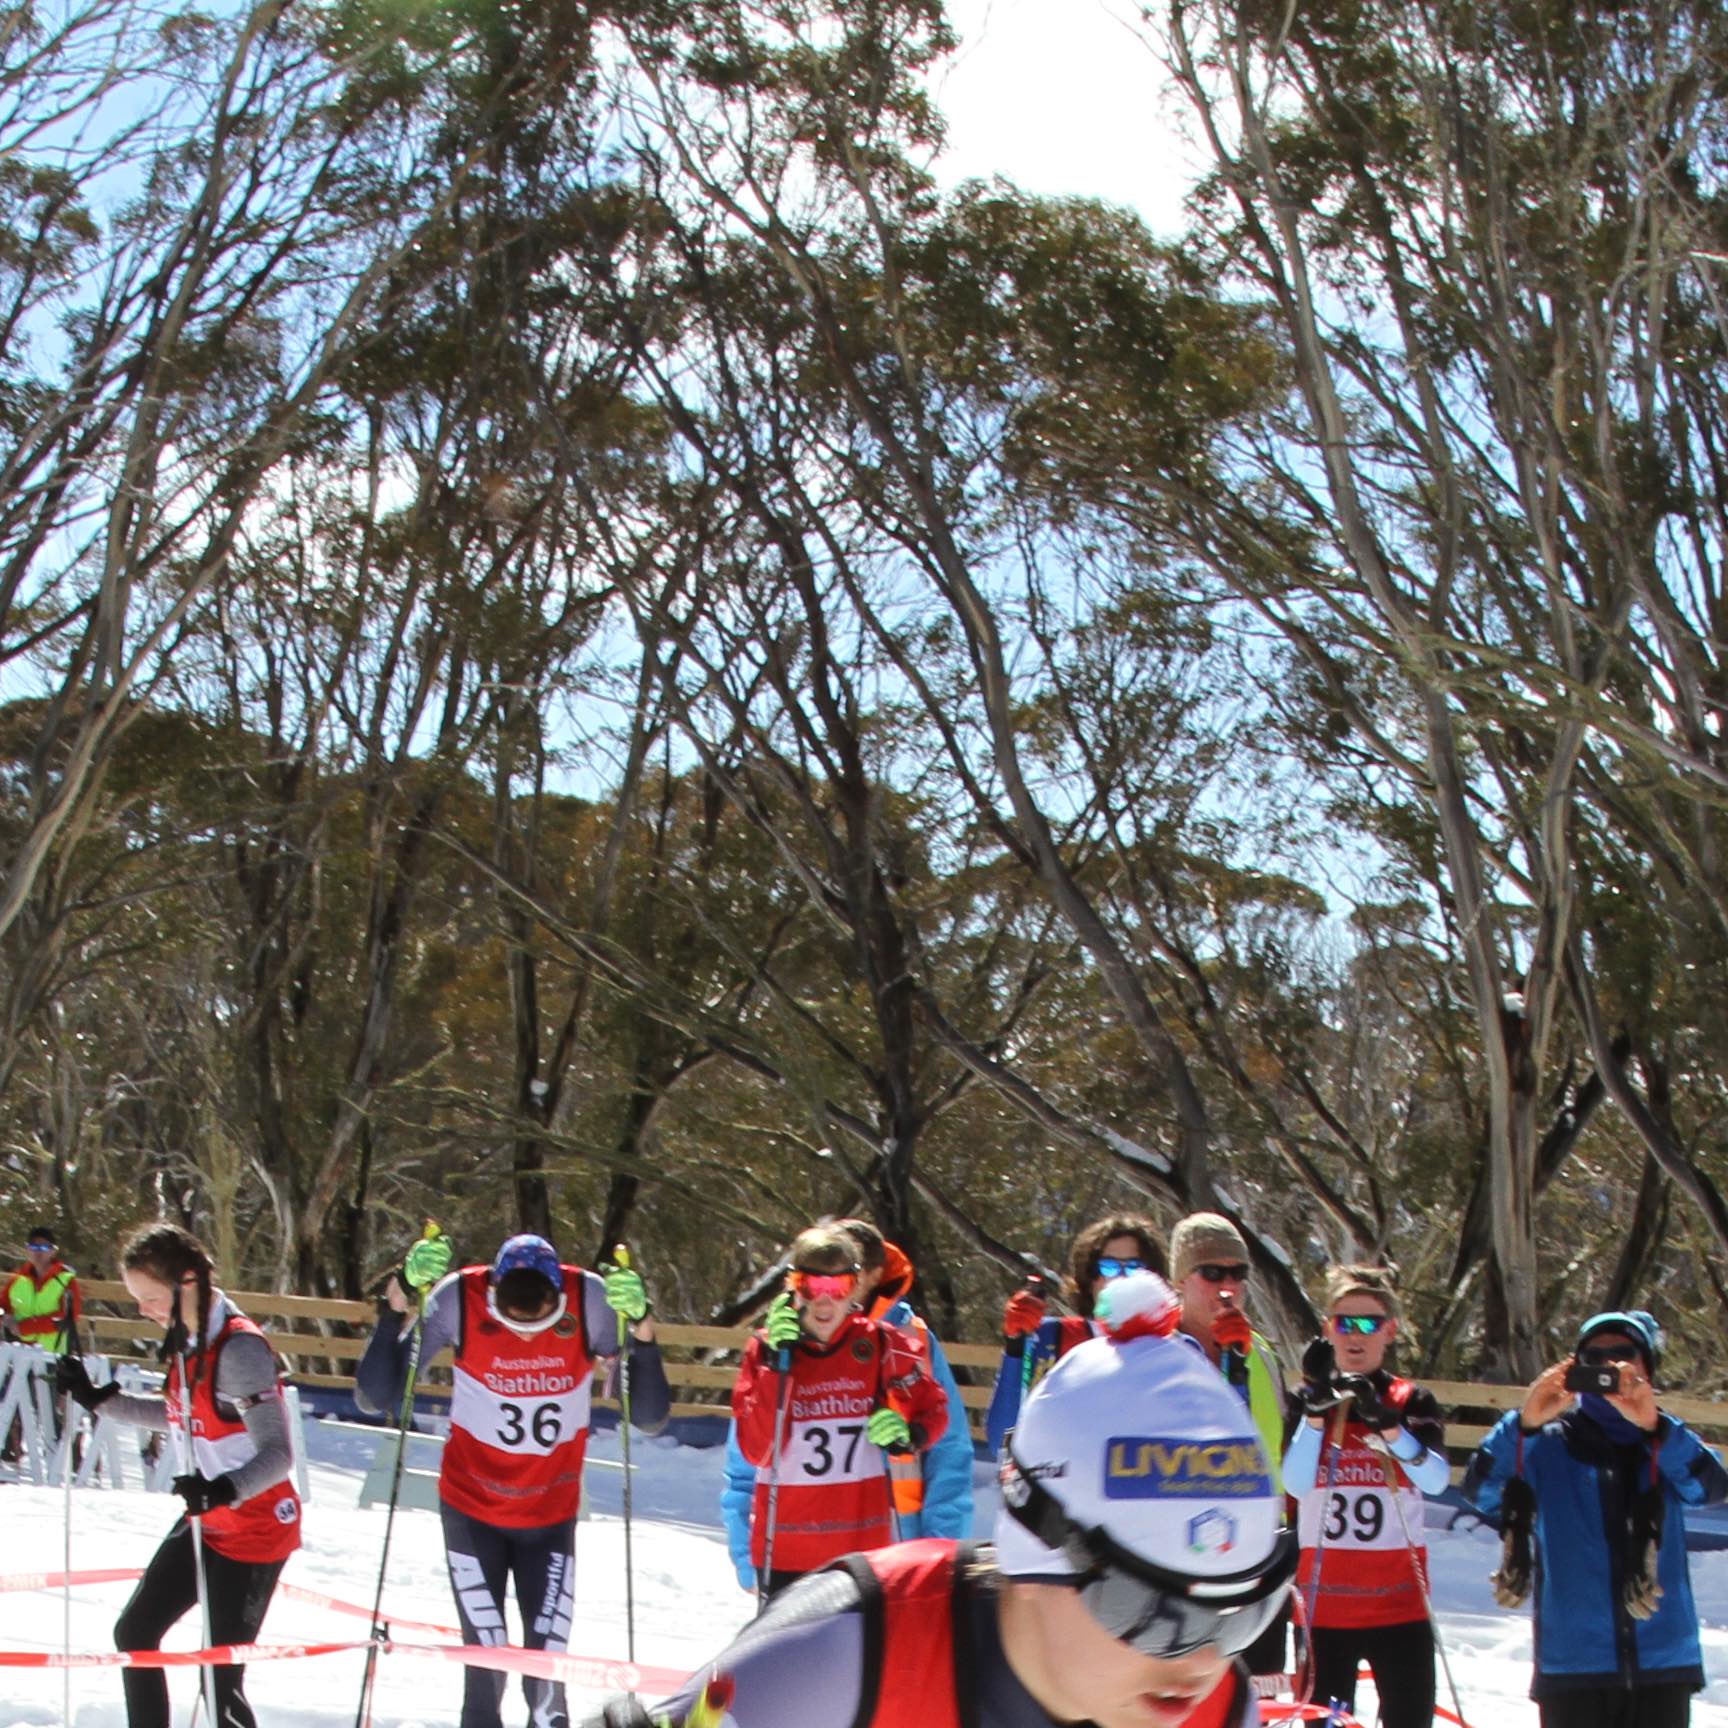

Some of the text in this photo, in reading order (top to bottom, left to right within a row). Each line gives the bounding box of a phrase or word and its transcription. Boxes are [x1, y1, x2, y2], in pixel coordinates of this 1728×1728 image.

[491, 1354, 566, 1372] Australian
[483, 1371, 574, 1394] Biathlon
[797, 1376, 865, 1397] Australian
[497, 1402, 563, 1448] 36
[802, 1424, 865, 1477] 37
[1317, 1462, 1385, 1485] Bathlo
[1324, 1491, 1385, 1543] 39
